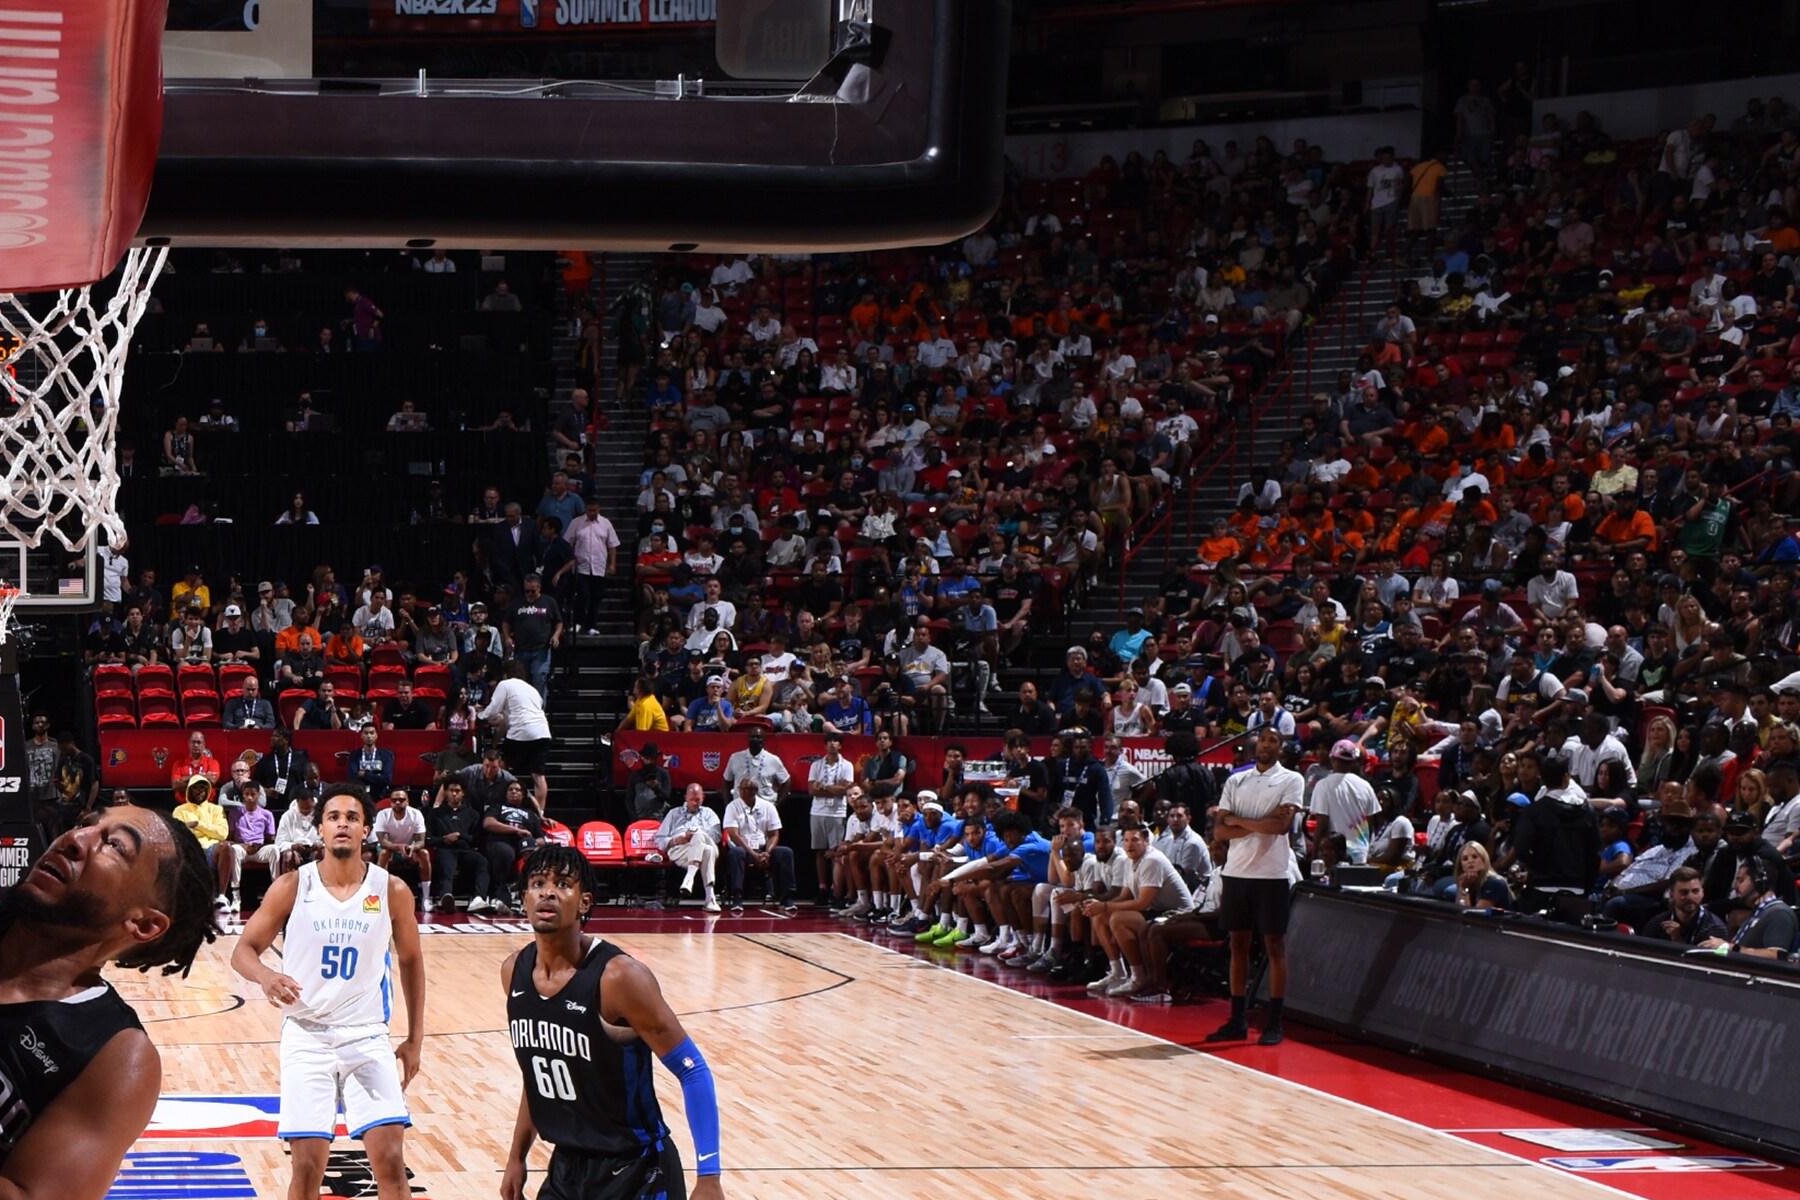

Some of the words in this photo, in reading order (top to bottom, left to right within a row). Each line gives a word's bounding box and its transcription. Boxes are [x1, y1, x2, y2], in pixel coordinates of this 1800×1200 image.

[555, 0, 641, 26] SUMMER
[648, 0, 717, 24] LEAGU
[313, 918, 370, 934] OKLAHOMA
[328, 932, 352, 944] CITY
[321, 945, 359, 981] 50
[510, 1018, 592, 1062] ORLANDO
[1392, 947, 1471, 1019] ACCESS
[1457, 961, 1499, 1024] TO
[1486, 966, 1542, 1036] THE
[1581, 987, 1694, 1073] PREMIER
[1673, 1007, 1788, 1097] EVENTS
[531, 1055, 577, 1102] 60
